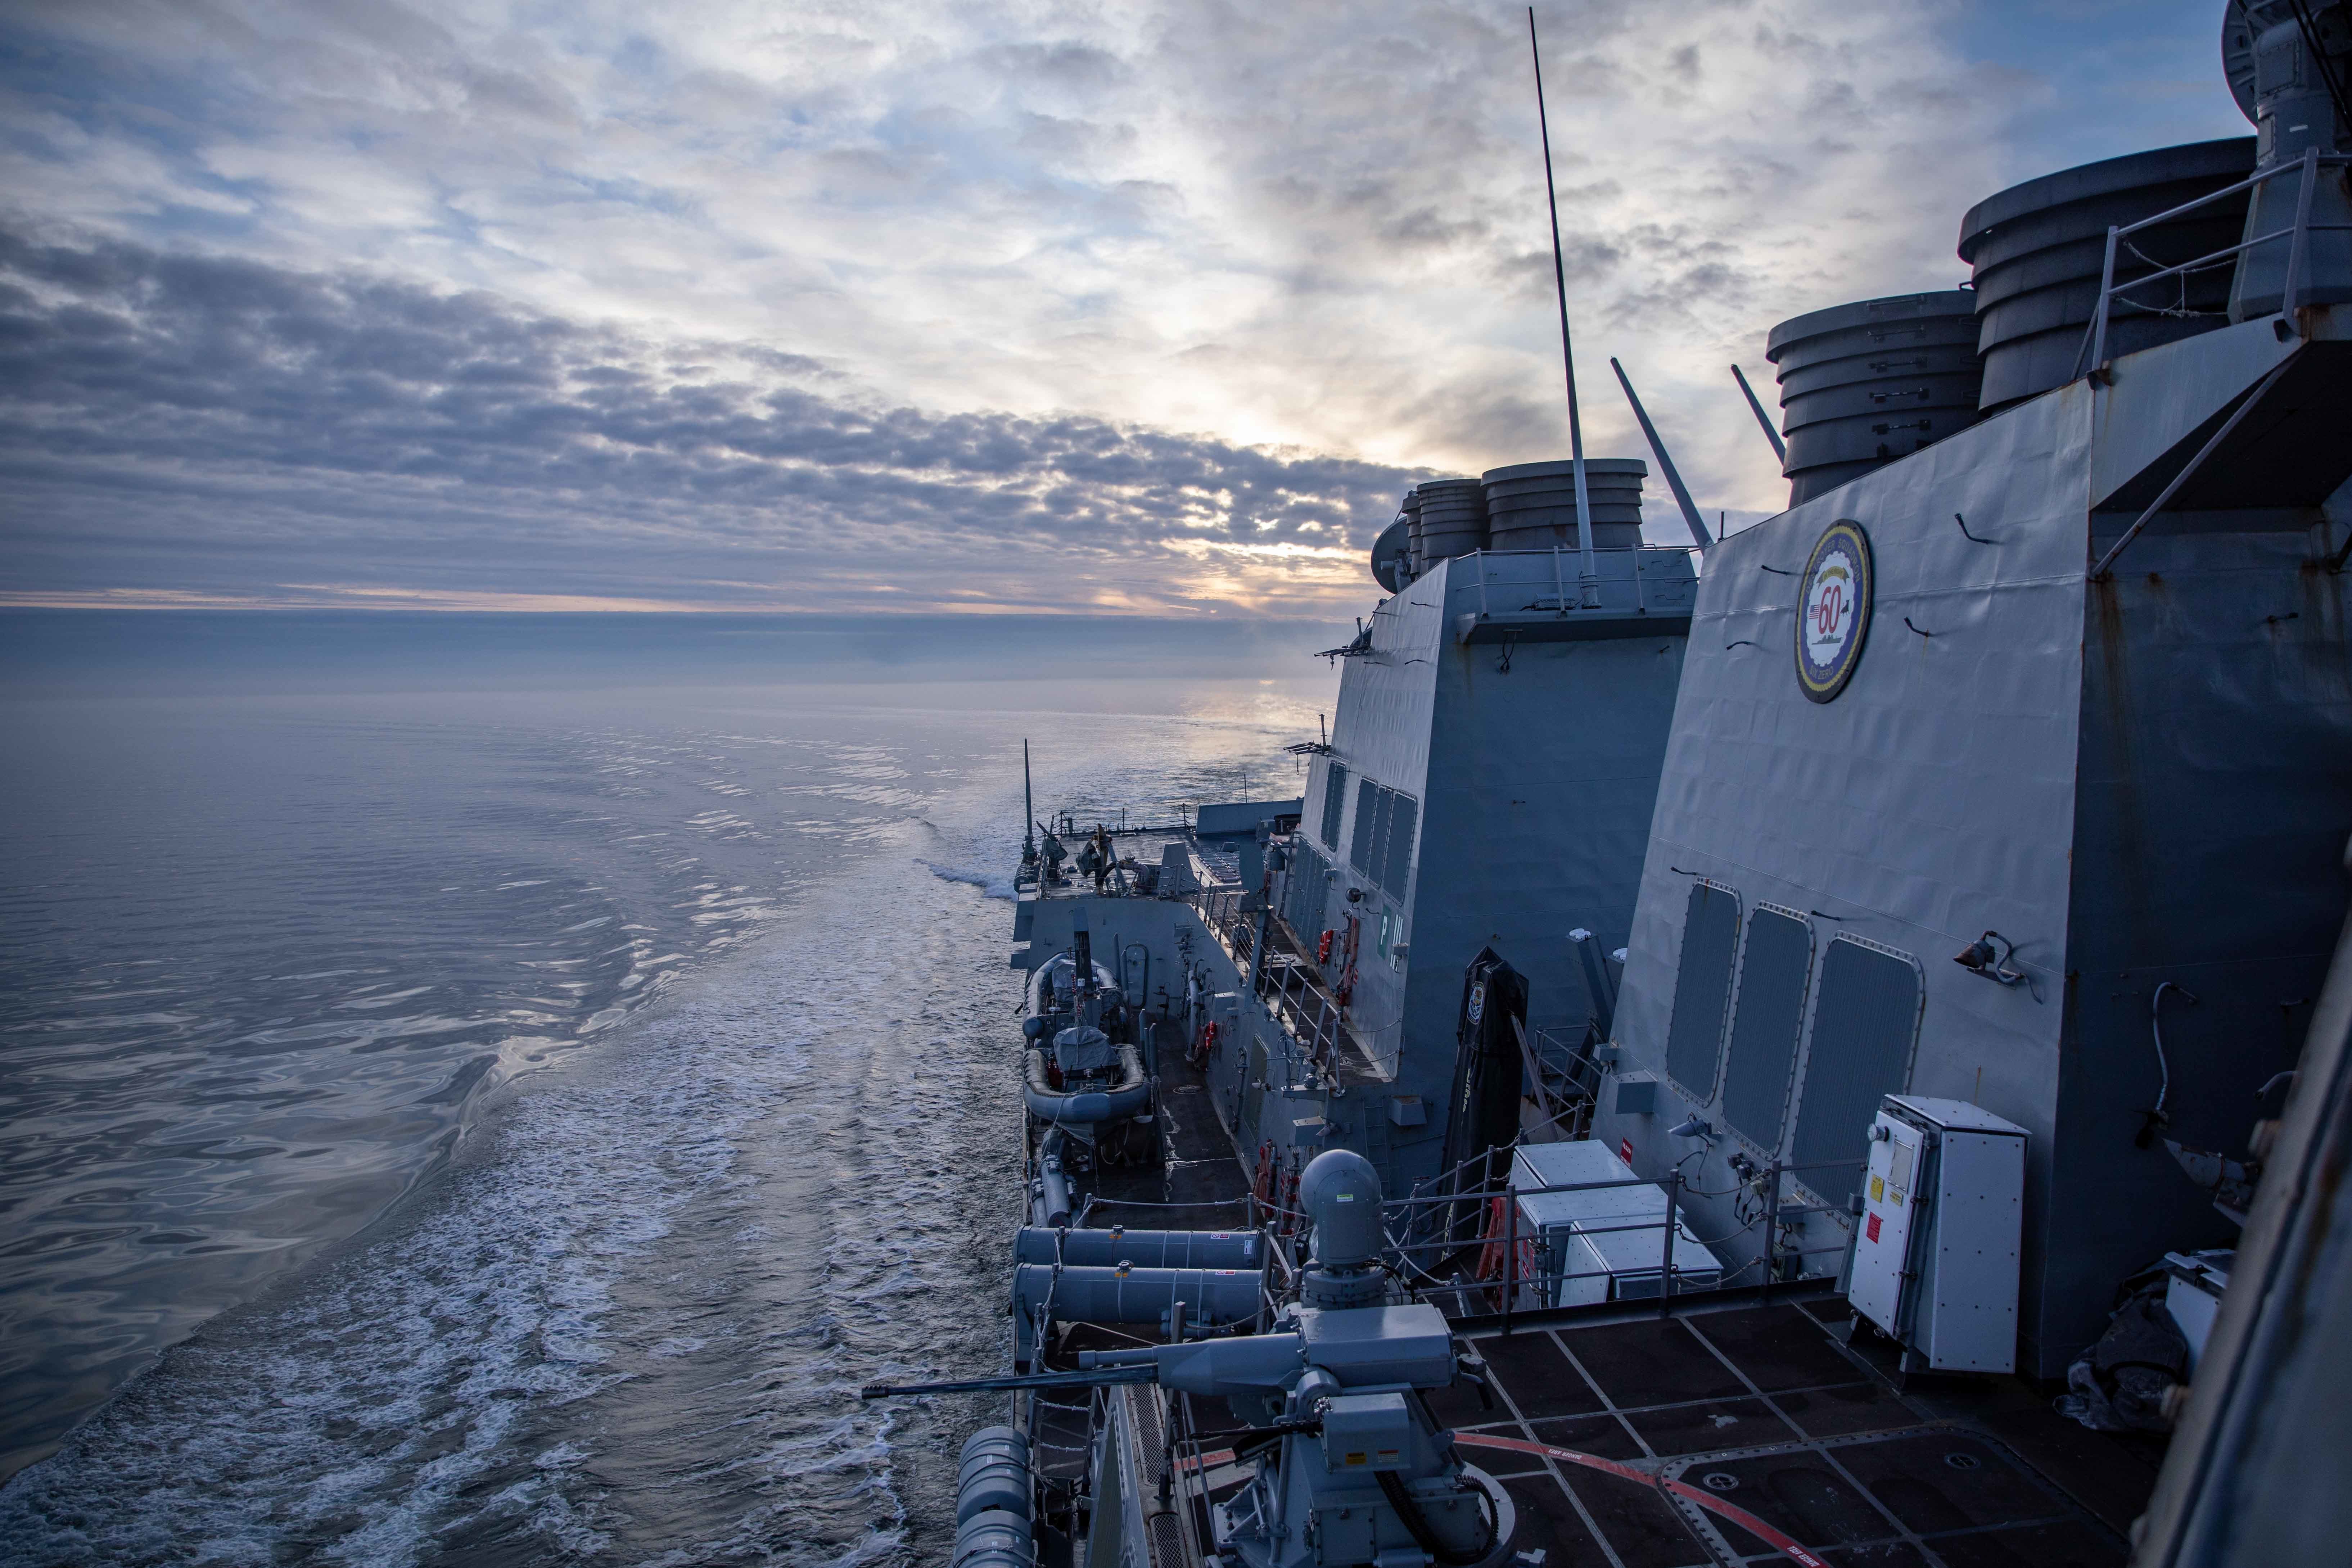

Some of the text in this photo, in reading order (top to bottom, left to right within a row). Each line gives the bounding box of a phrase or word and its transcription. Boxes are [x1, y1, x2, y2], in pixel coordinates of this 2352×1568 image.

[1806, 538, 1860, 594] DESTROYER SQUADRON
[1819, 585, 1841, 634] 60
[1809, 665, 1834, 680] SIX ZERO
[1787, 1546, 1820, 1567] DANGER AREA
